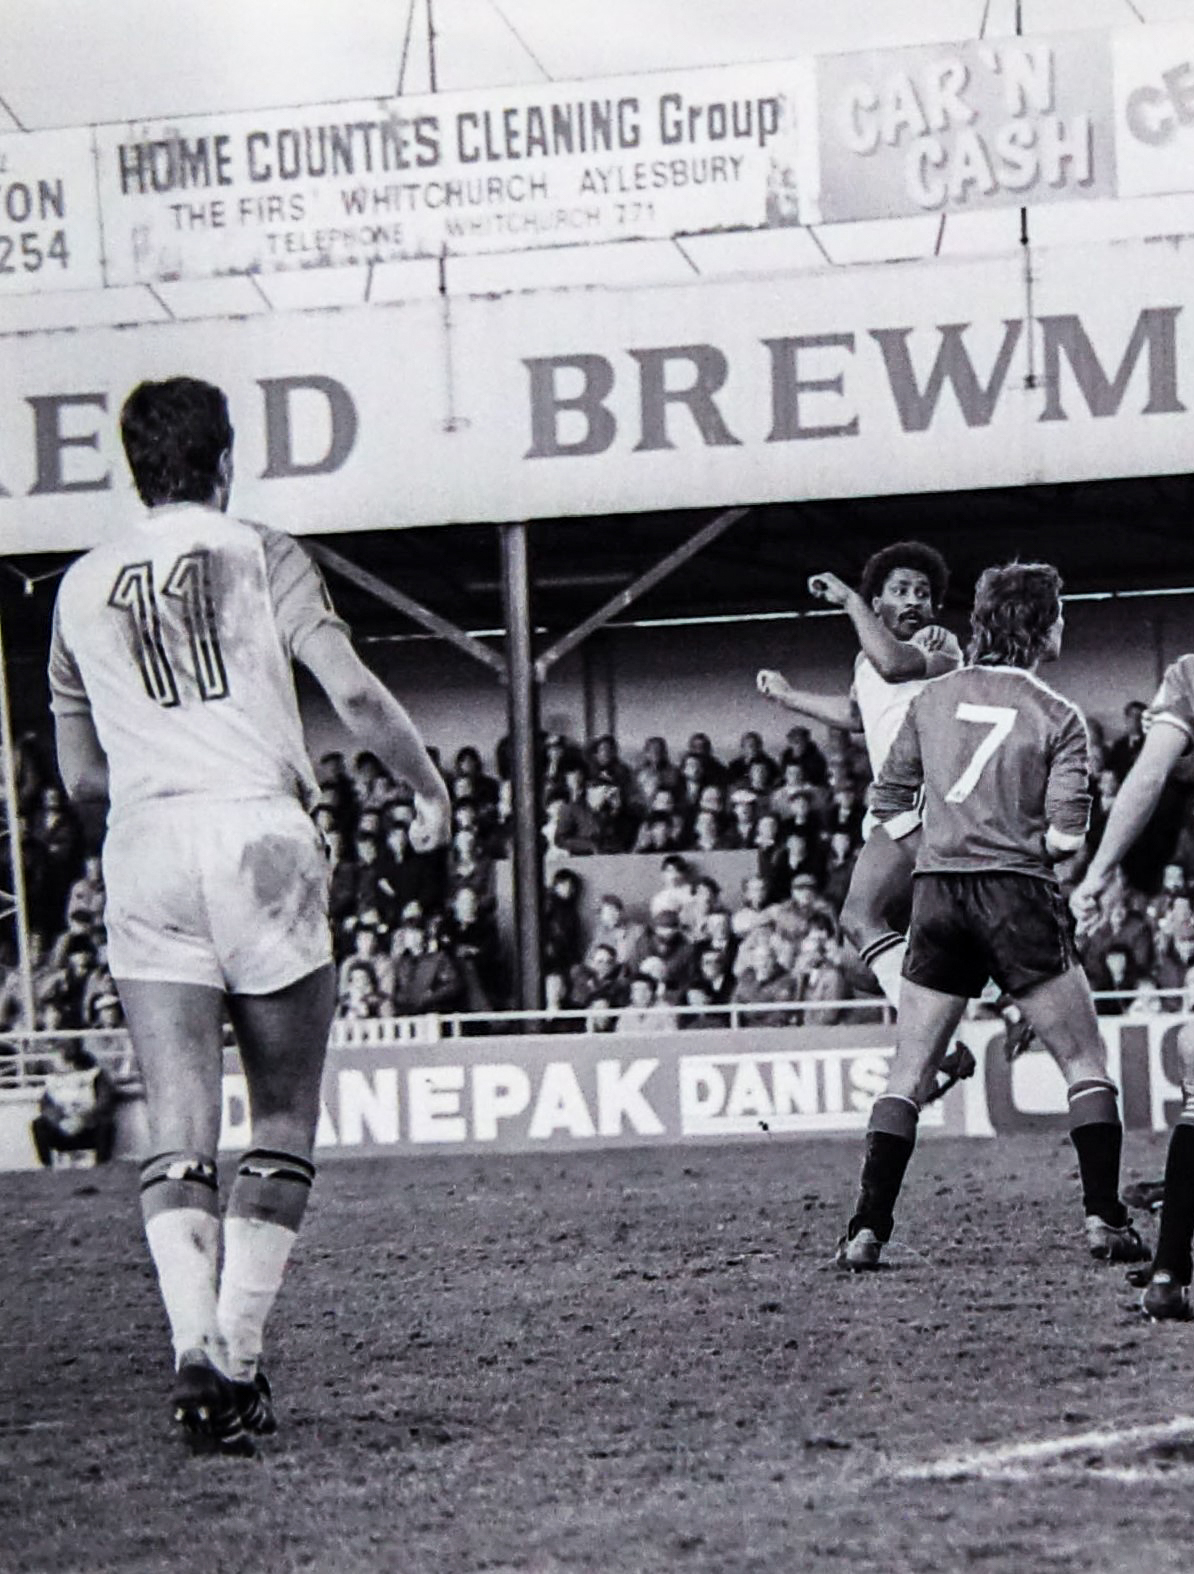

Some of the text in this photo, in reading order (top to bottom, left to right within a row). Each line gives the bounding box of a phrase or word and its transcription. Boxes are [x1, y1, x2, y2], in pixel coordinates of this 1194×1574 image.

[117, 92, 779, 194] HOME COUNTIES CLEANING Group
[839, 57, 980, 157] CAR
[0, 177, 66, 223] ON
[169, 154, 745, 230] THE FIRS WHITCHURCH AYLESBURY
[906, 114, 1095, 211] CASH
[107, 549, 230, 708] 11
[945, 702, 1019, 804] 7
[216, 1057, 664, 1149] DNEPAK
